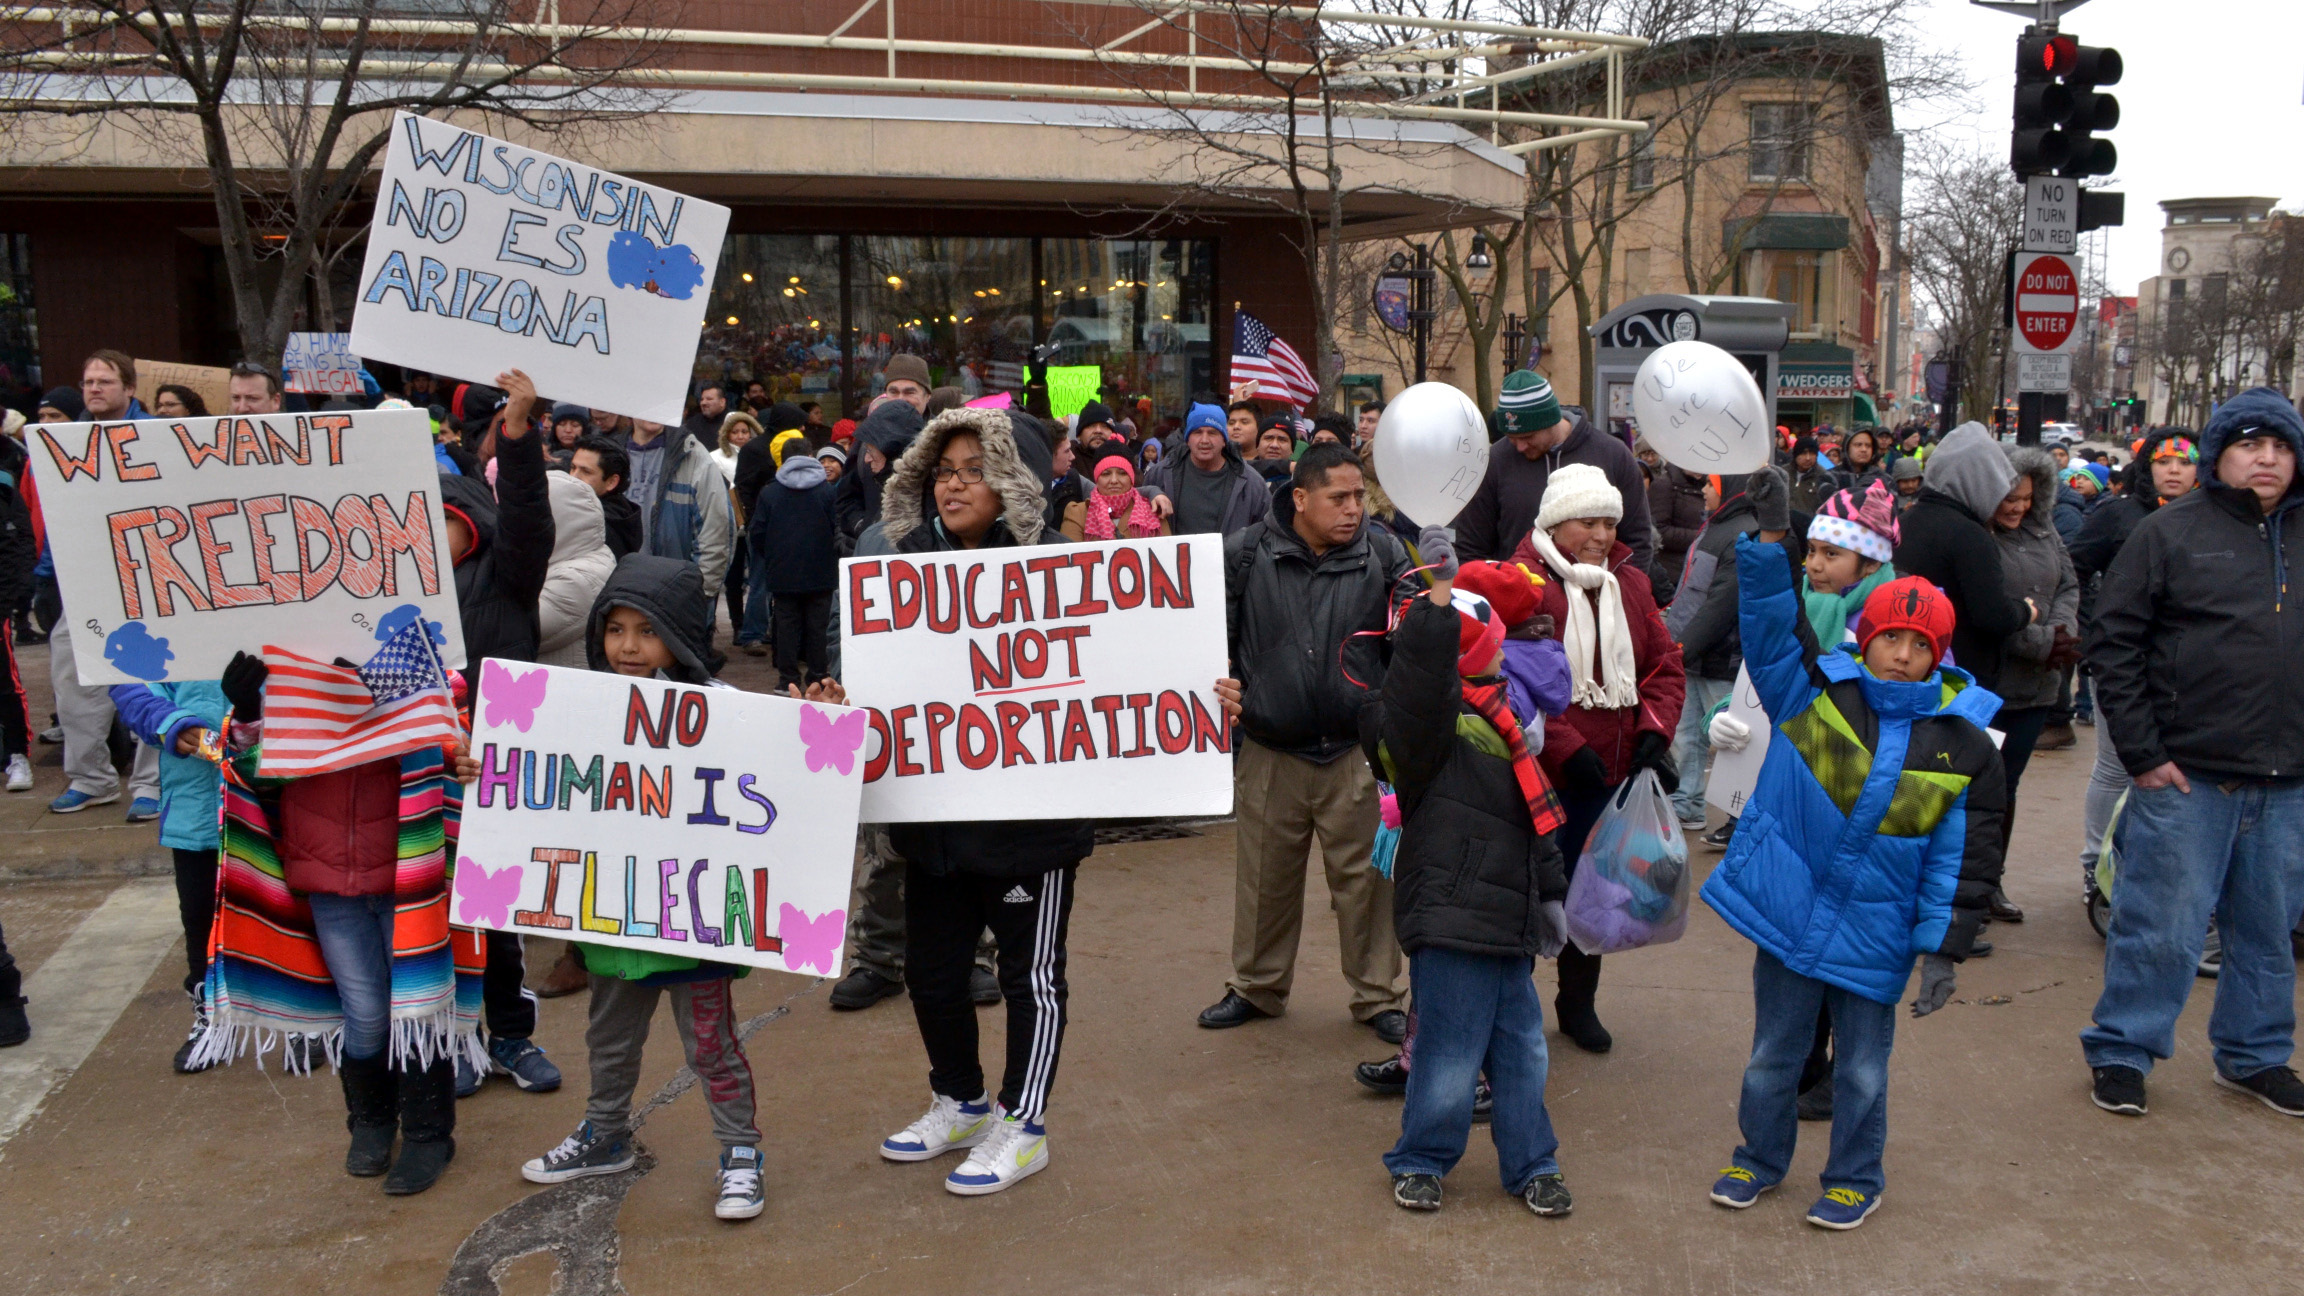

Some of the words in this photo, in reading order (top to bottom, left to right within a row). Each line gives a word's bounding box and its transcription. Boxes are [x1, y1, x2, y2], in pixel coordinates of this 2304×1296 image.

[404, 115, 684, 246] WISCONSIN
[2042, 184, 2064, 202] NO
[387, 178, 467, 244] NO
[496, 208, 587, 276] ES
[2029, 228, 2045, 243] ON
[2050, 229, 2072, 244] RED
[2037, 208, 2066, 223] TURN
[363, 250, 610, 355] ARIZONA
[2026, 274, 2043, 289] DO
[2046, 275, 2070, 290] NOT
[309, 332, 353, 354] HUMA
[2026, 317, 2067, 333] ENTER
[285, 352, 330, 371] BEING
[334, 353, 360, 371] IS
[285, 370, 364, 394] ILLEGAL
[1642, 356, 1697, 402] We
[1670, 392, 1709, 429] are
[37, 423, 162, 483] WE
[170, 414, 354, 469] WANT
[106, 490, 440, 620] FREEDOM
[849, 543, 1195, 636] EDUCATION
[969, 625, 1091, 692] NOT
[624, 683, 708, 749] NO
[863, 689, 1232, 784] DEPORTATION
[477, 743, 673, 819] HUMAN
[687, 767, 778, 835] IS
[514, 847, 784, 955] ILLEGAL
[1003, 895, 1033, 903] adidas
